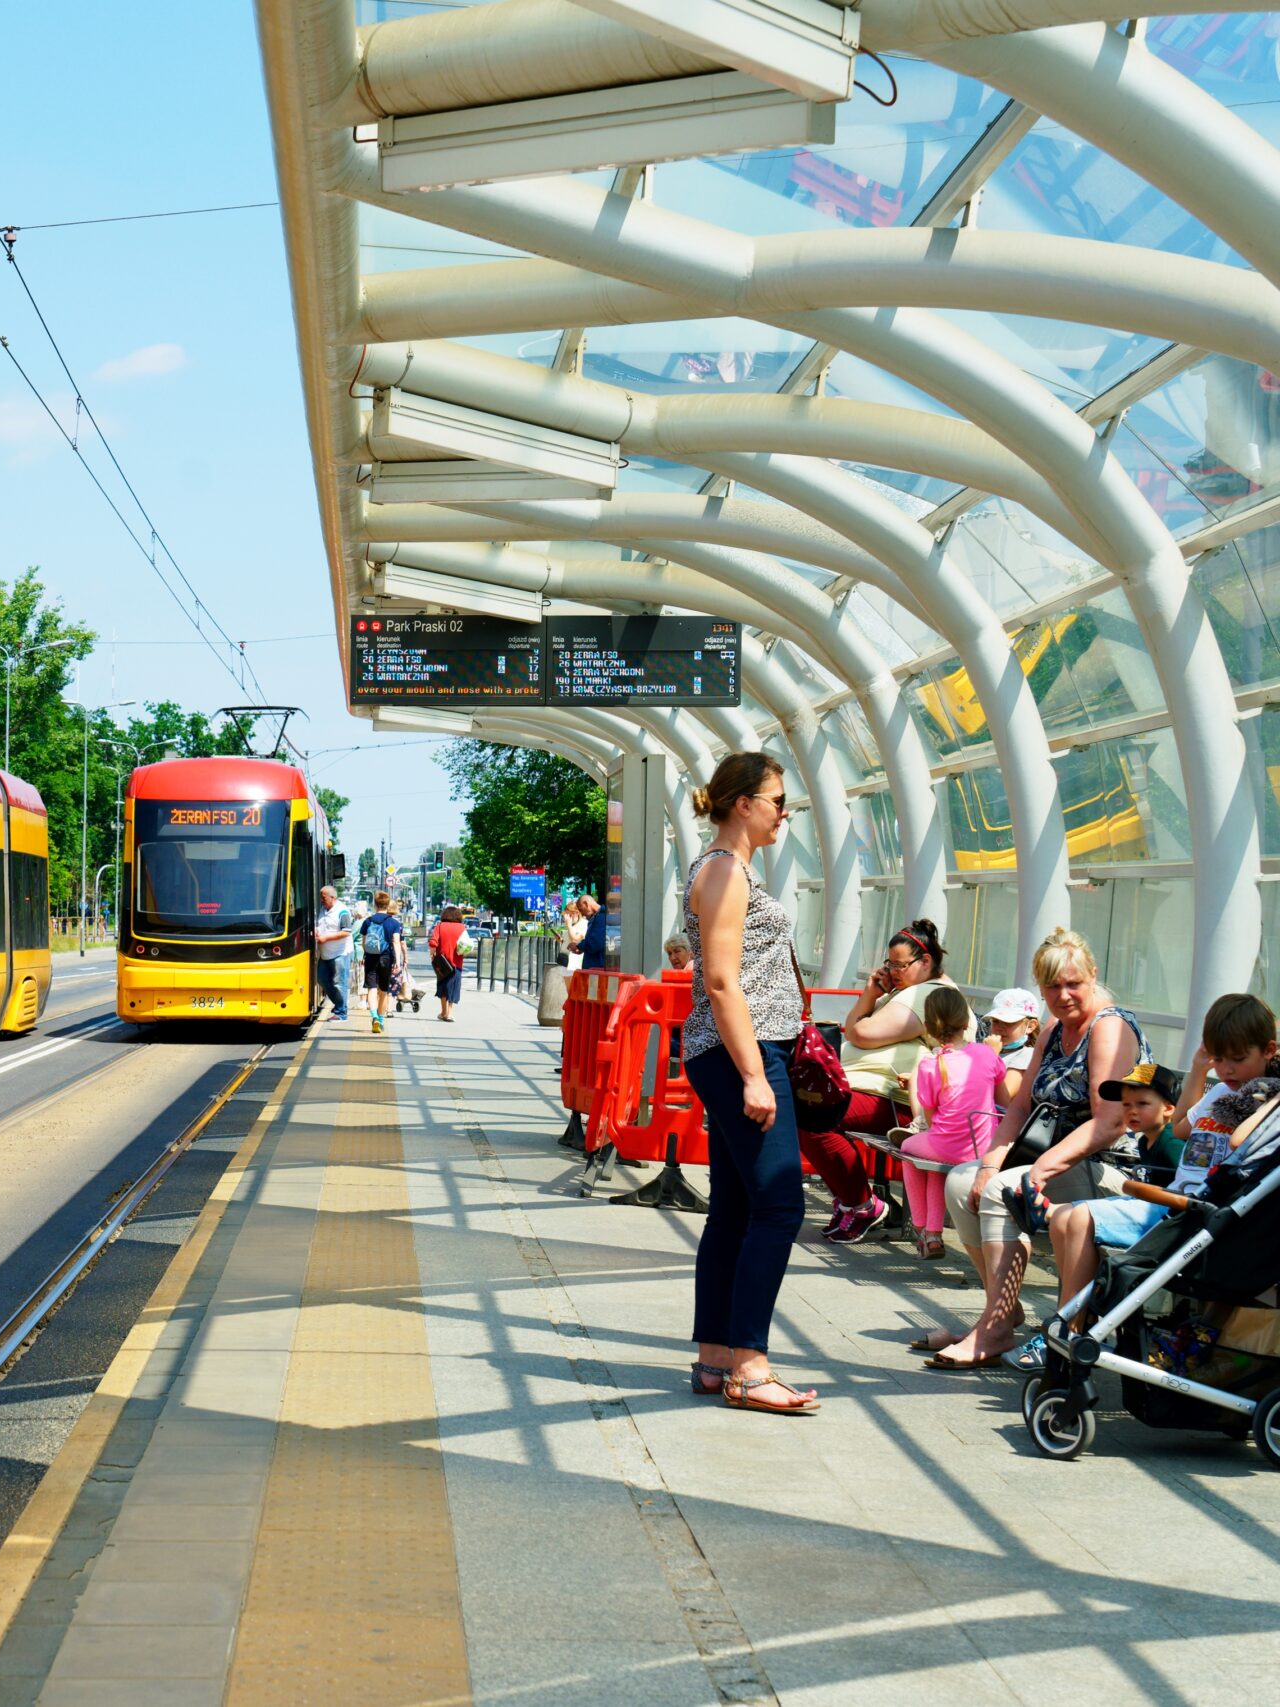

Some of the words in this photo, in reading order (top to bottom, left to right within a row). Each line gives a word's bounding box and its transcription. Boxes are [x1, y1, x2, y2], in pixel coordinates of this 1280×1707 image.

[386, 620, 411, 632] Park
[414, 620, 446, 632] Praski
[449, 620, 463, 632] 02
[559, 651, 571, 659] 20
[602, 651, 618, 659] FSO
[362, 656, 374, 664] 20
[405, 656, 422, 664] FSO
[528, 656, 539, 664] 12
[559, 659, 570, 668] 26
[573, 659, 626, 668] WIATRACZNA
[528, 664, 539, 672] 17
[602, 668, 644, 676] WSCHODNI
[362, 673, 374, 681] 26
[376, 673, 430, 681] WIATRACZNA
[528, 673, 539, 681] 18
[555, 677, 570, 685] 190
[572, 677, 583, 685] CH
[585, 677, 611, 685] MARKI
[382, 687, 403, 695] your
[437, 685, 455, 694] and
[483, 686, 503, 694] with
[559, 685, 570, 693] 13
[212, 810, 237, 825] FSO
[242, 807, 261, 826] 20
[190, 996, 224, 1008] 3824
[1182, 1241, 1202, 1260] mutsy
